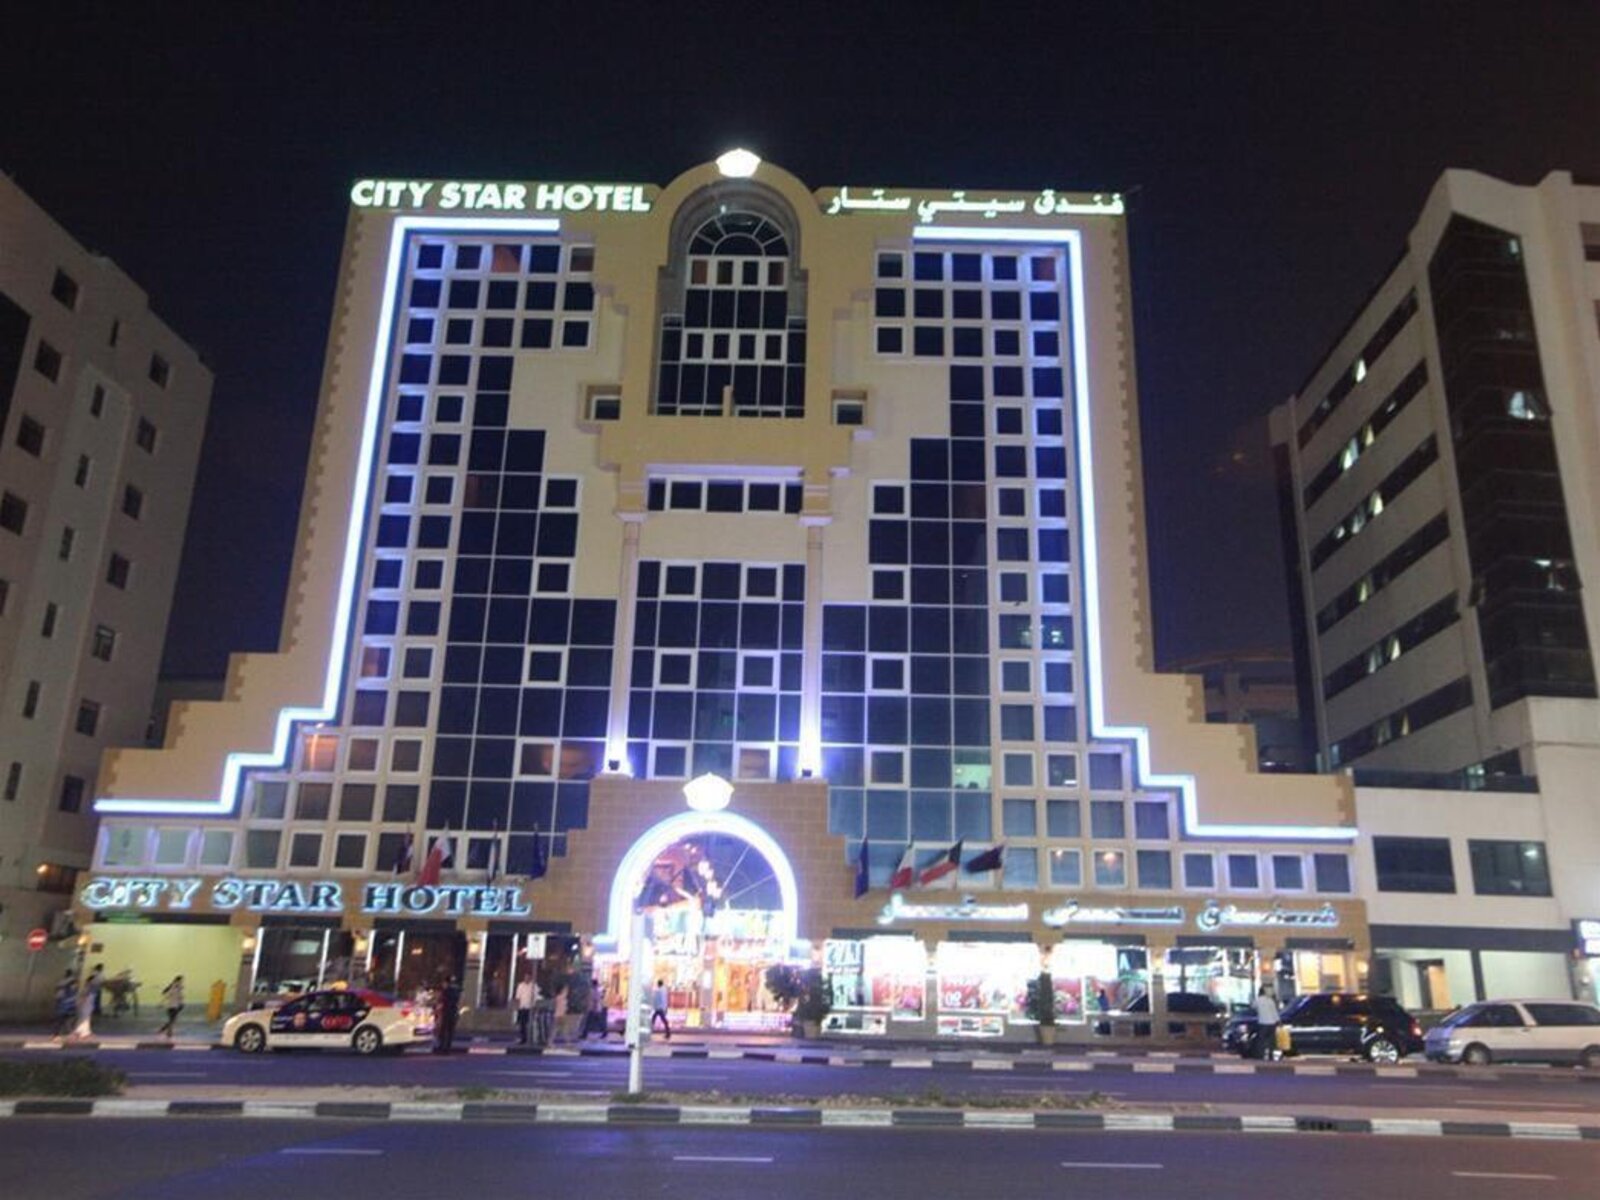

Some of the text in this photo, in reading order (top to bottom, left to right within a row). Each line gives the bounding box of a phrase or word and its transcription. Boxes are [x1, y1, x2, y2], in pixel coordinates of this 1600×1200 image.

[350, 179, 651, 212] CITY STAR HOTEL
[827, 186, 1125, 223] فندق سيتي ستار
[81, 876, 532, 917] CITY STAR HOTEL
